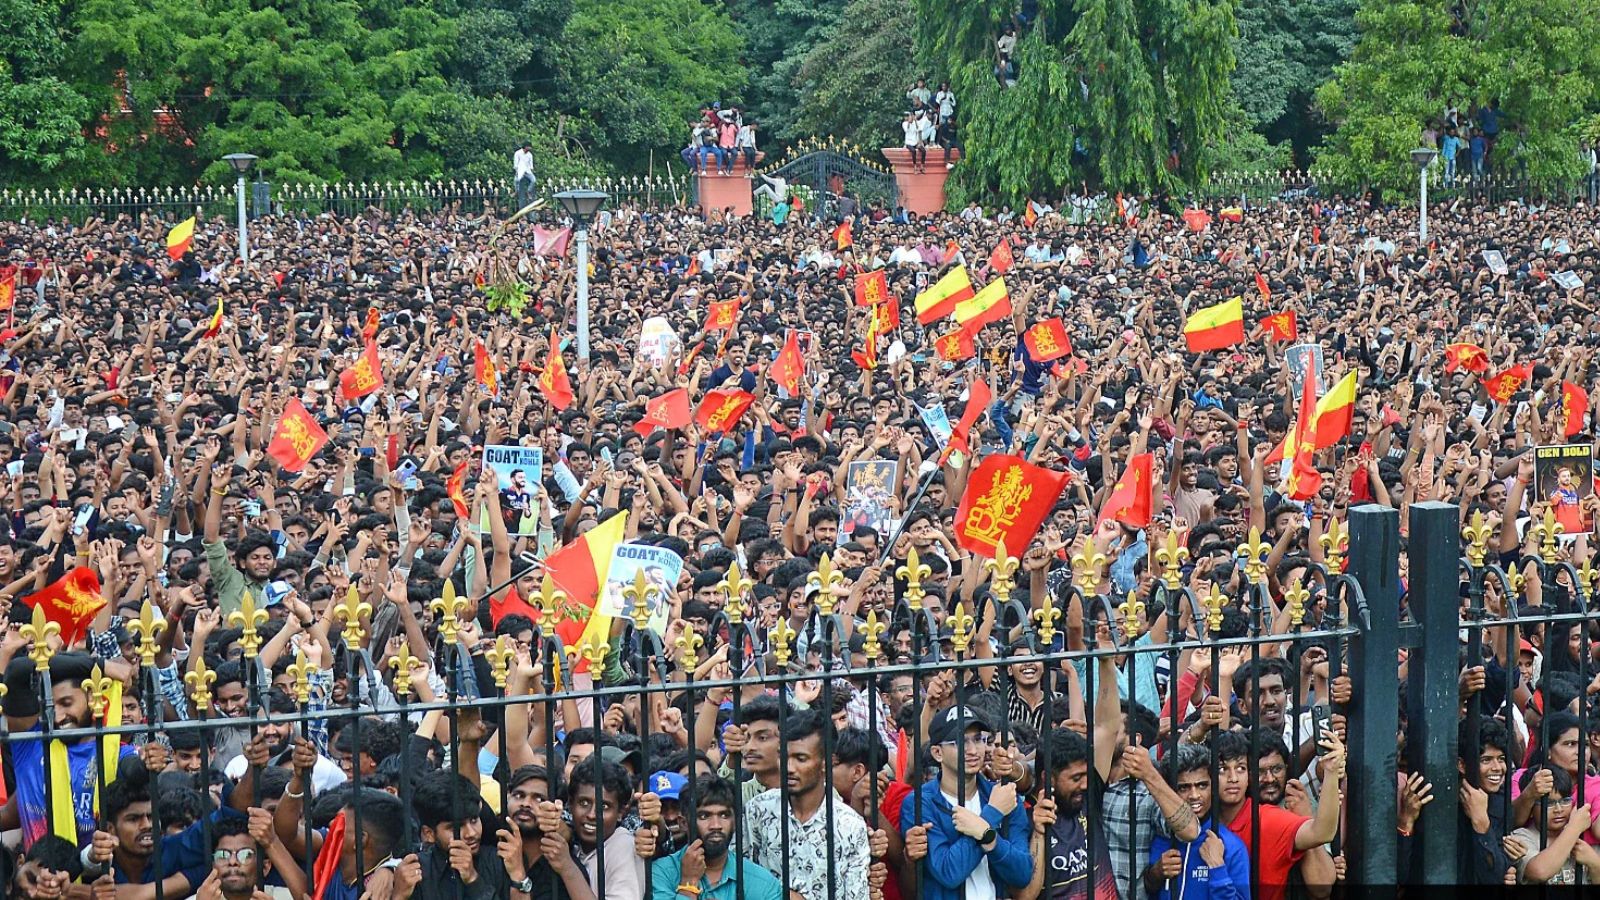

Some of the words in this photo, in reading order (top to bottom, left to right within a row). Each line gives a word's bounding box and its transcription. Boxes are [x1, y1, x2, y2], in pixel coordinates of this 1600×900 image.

[486, 449, 520, 464] GOAT
[1537, 447, 1560, 458] GEN
[1562, 446, 1590, 457] BOLD
[617, 546, 660, 561] GOAT
